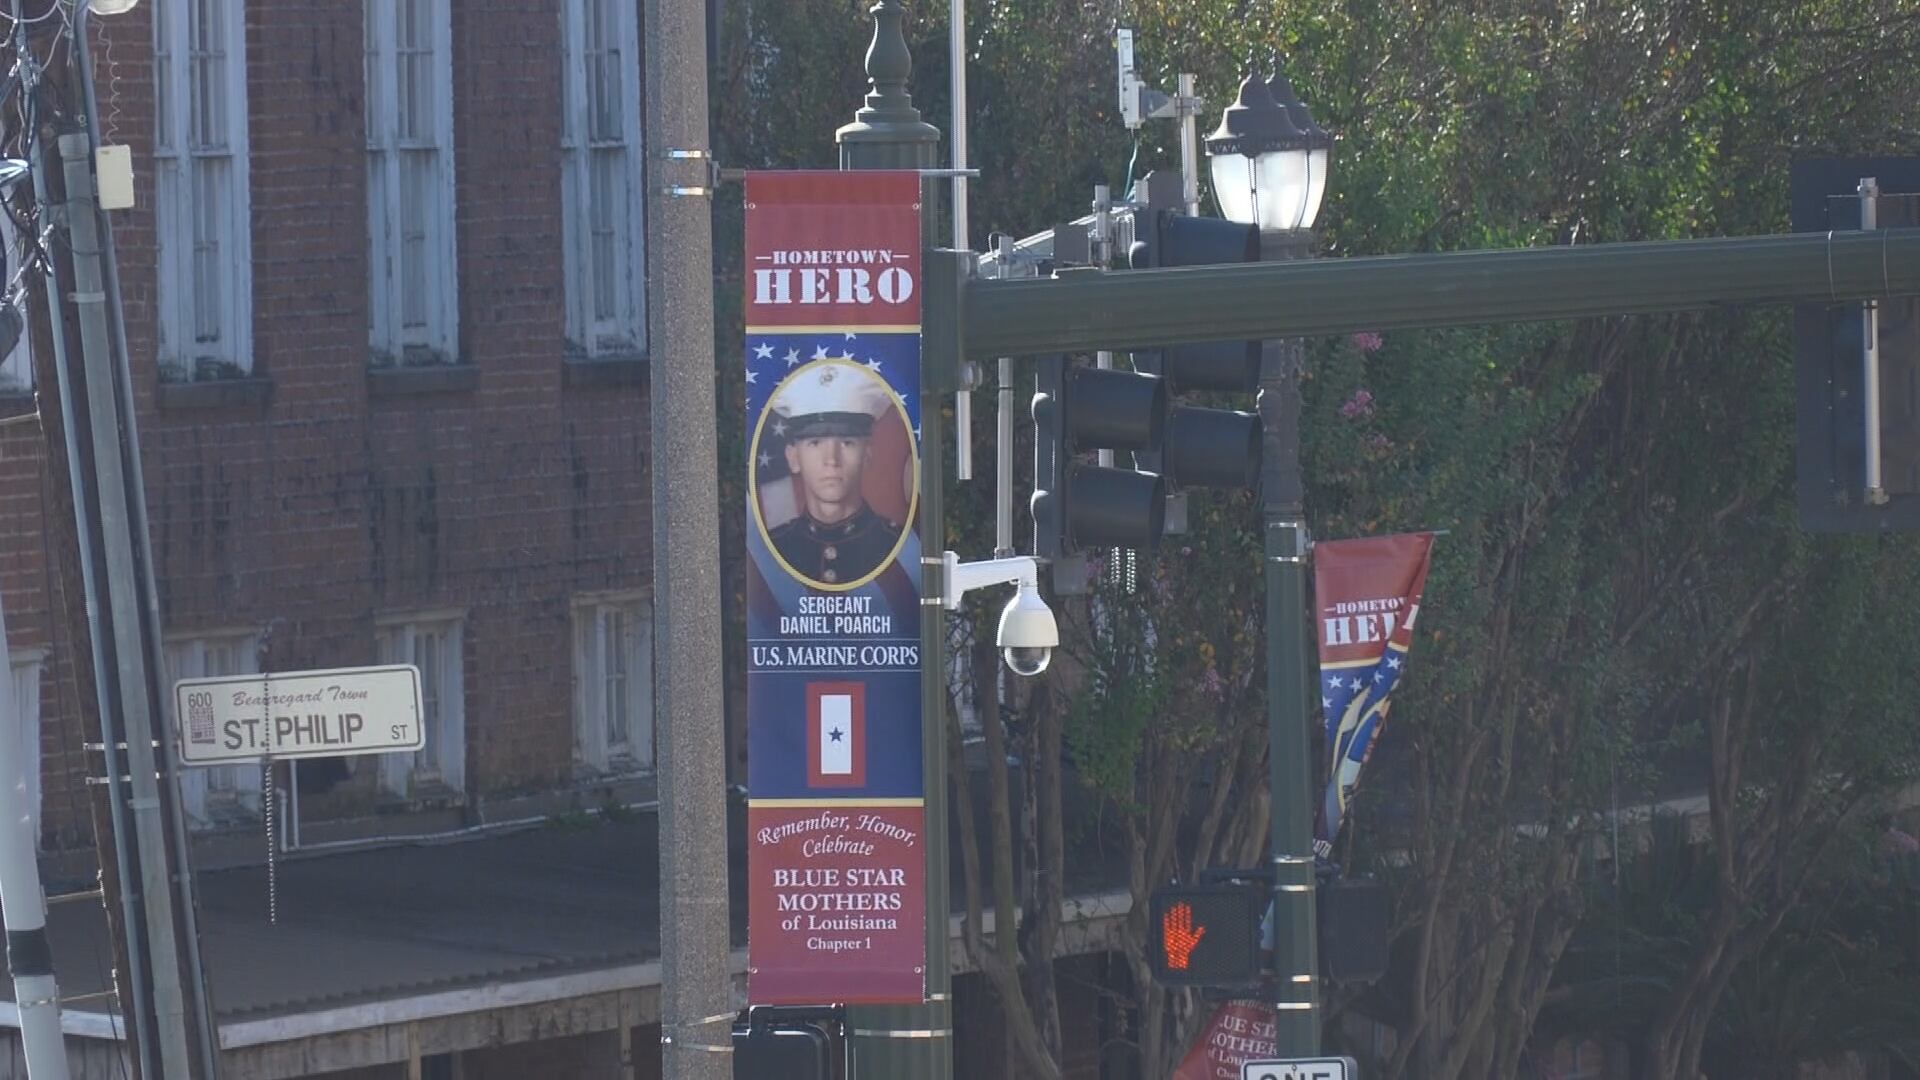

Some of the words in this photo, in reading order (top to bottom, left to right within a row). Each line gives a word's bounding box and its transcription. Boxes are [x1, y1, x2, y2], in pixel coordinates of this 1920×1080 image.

[773, 250, 892, 265] HOMETOWN
[753, 267, 914, 304] HERO
[799, 596, 872, 614] SERGEANT
[780, 616, 831, 634] DANIEL
[835, 615, 891, 634] POARCH
[752, 647, 783, 666] U.S.
[787, 646, 858, 666] MARINE
[861, 646, 919, 666] CORPS
[188, 691, 213, 708] 600
[327, 685, 368, 702] Town
[275, 713, 363, 746] PHILIP
[391, 724, 408, 740] ST
[757, 811, 850, 845] Remember,
[856, 814, 917, 847] Honor,
[803, 835, 875, 857] Celebrate
[774, 868, 840, 887] BLUE
[846, 868, 906, 887] STAR
[777, 893, 902, 911] MOTHERS
[781, 915, 802, 931] of
[808, 914, 897, 931] Louisiana
[807, 936, 862, 953] Chapter
[865, 937, 872, 949] 1
